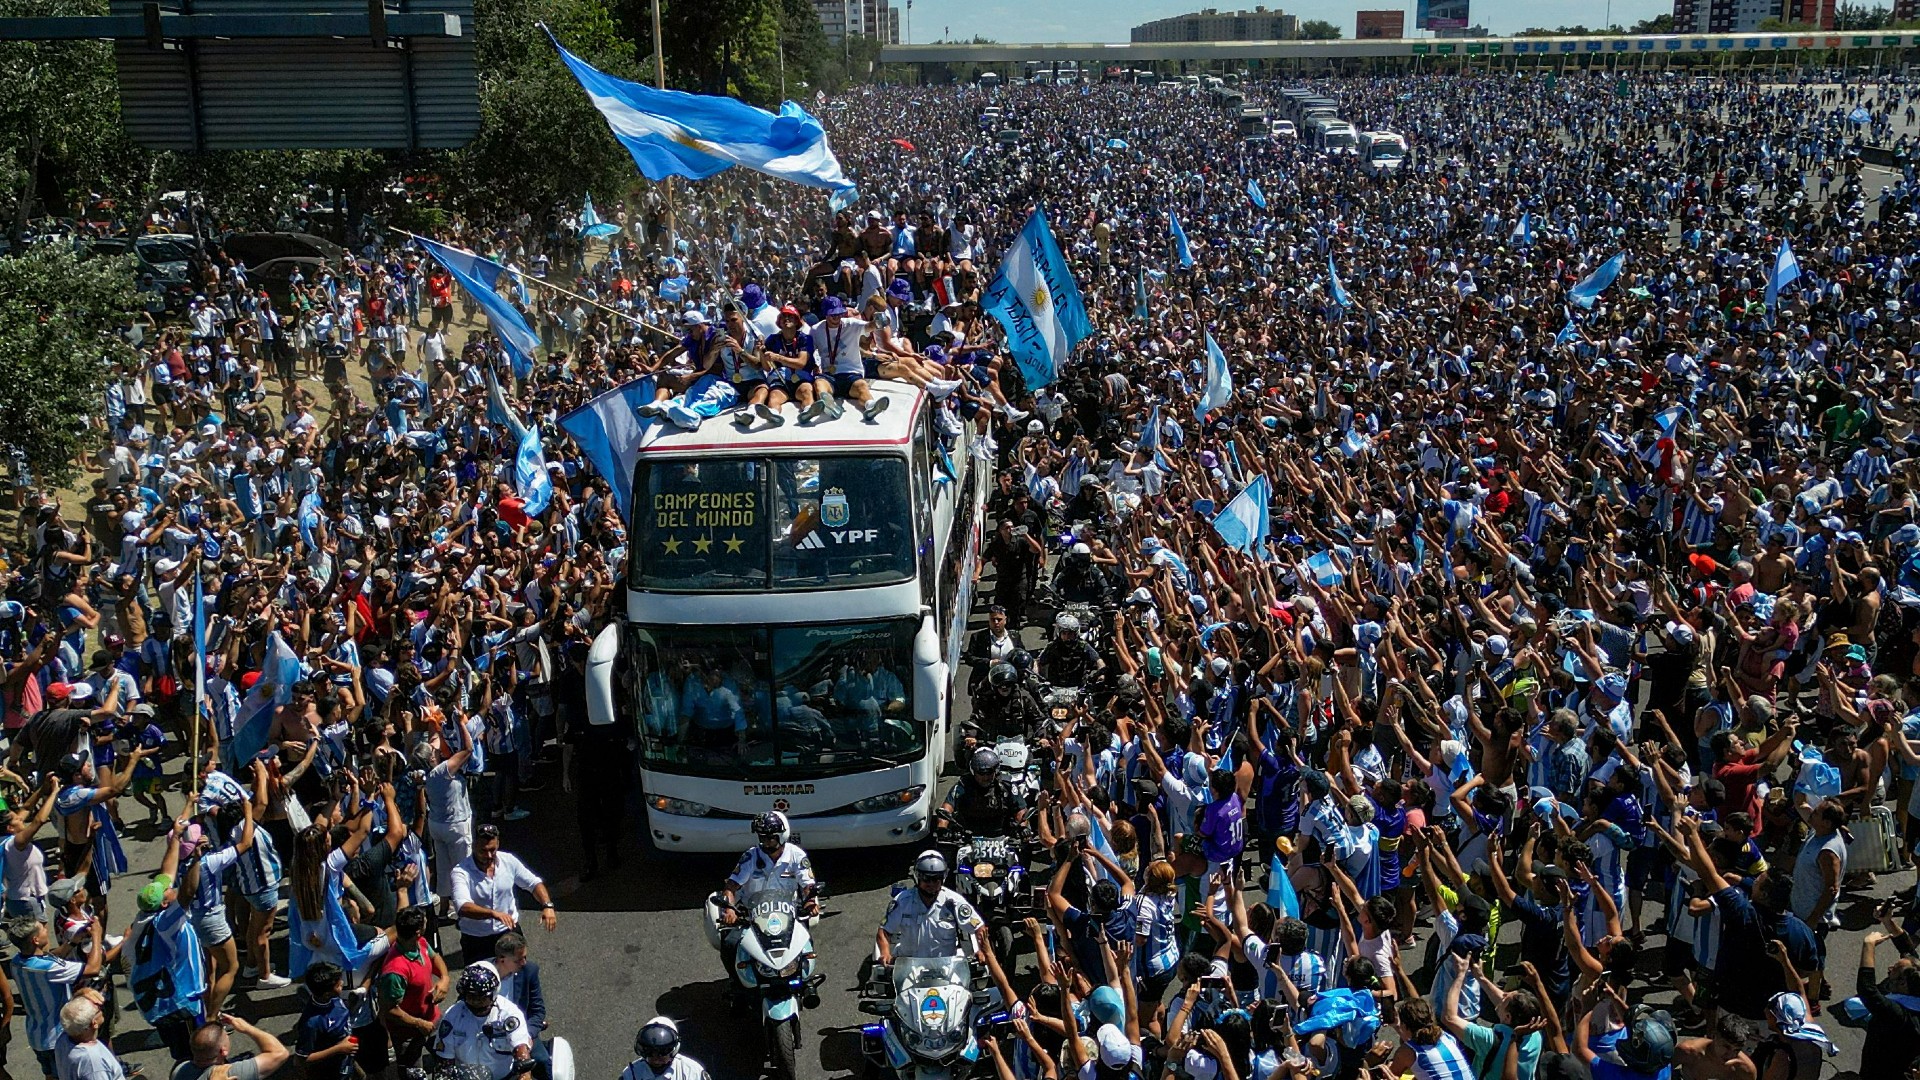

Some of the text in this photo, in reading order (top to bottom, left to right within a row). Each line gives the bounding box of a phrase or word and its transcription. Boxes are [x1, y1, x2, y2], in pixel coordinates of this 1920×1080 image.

[987, 274, 1009, 303] LA
[654, 492, 755, 510] CAMPEONES
[657, 511, 753, 528] DEL MUNDO
[830, 529, 878, 544] YPF
[743, 784, 815, 795] PLUSMAR
[1229, 818, 1242, 845] 10
[974, 847, 1006, 859] 25143
